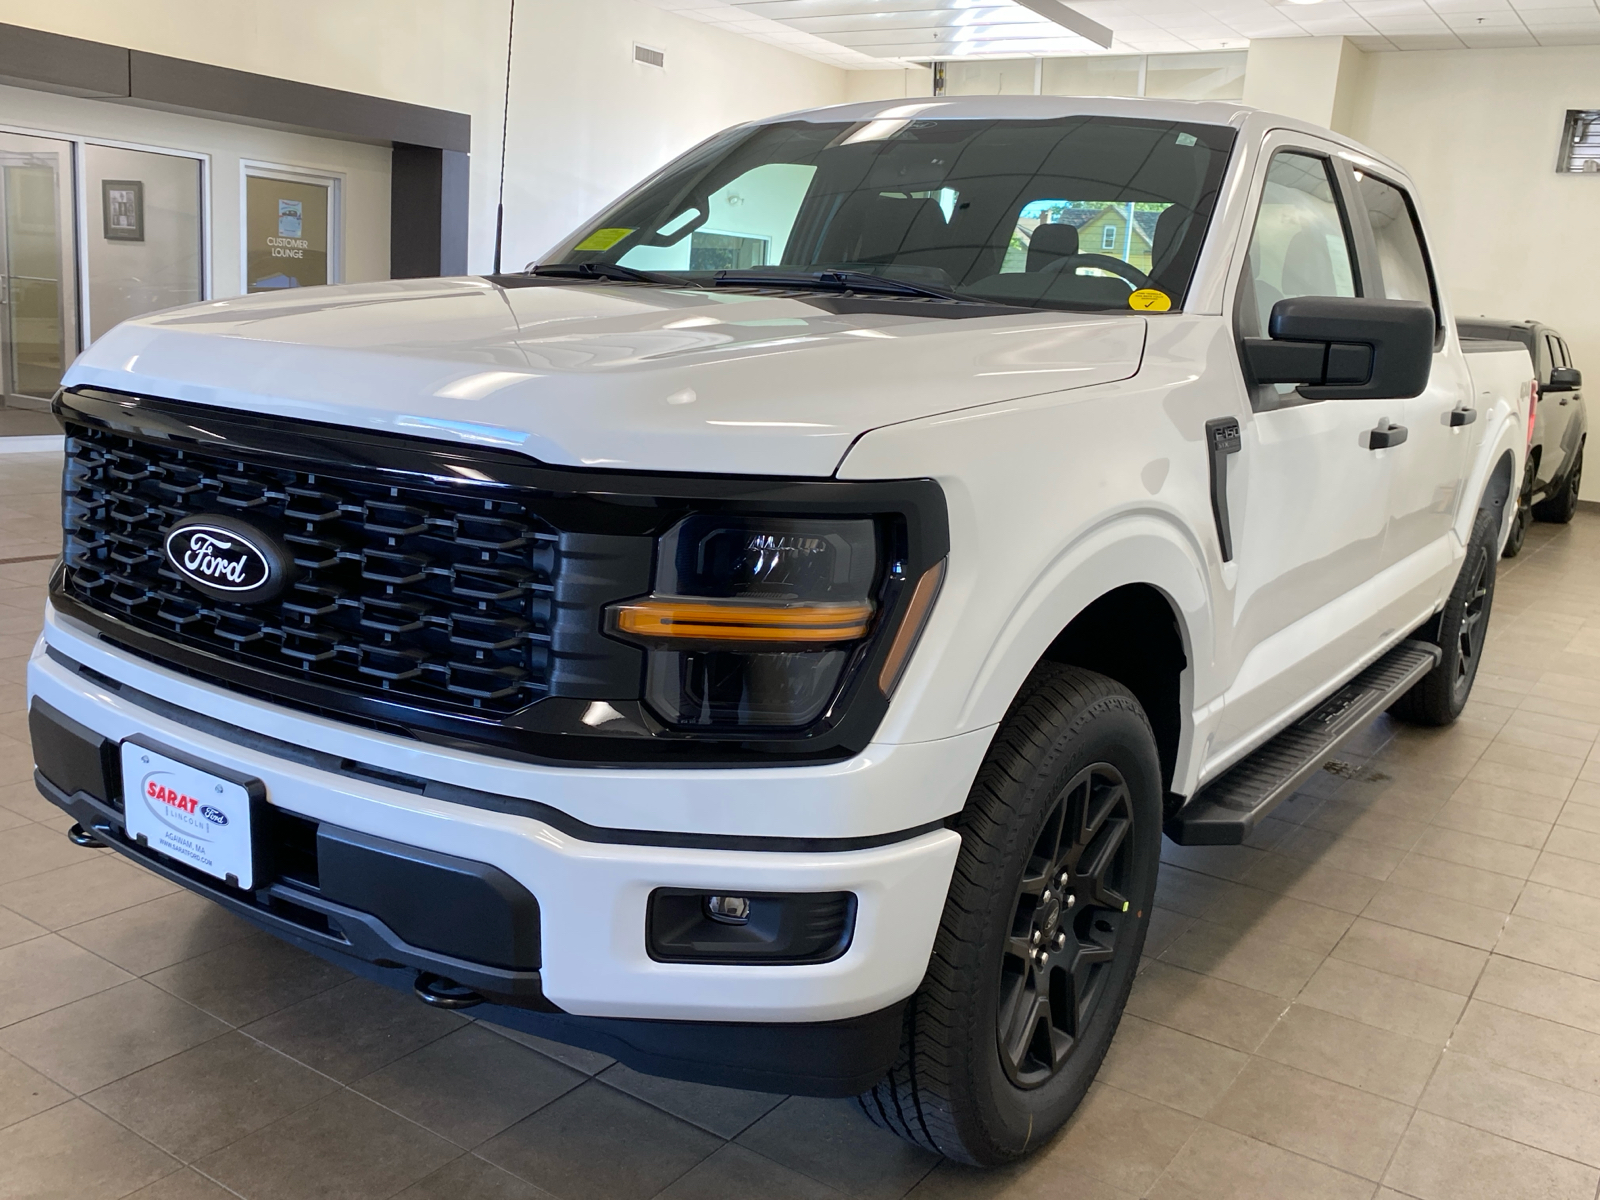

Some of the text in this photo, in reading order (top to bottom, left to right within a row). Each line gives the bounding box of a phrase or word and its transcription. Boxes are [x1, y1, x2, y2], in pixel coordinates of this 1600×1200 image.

[266, 236, 308, 249] CUSTOMER
[271, 247, 304, 259] LOUNGE
[1214, 426, 1240, 441] F-150
[184, 533, 248, 583] Ford
[146, 780, 199, 815] SARAT
[170, 809, 204, 830] LINCOLN
[203, 806, 225, 825] Ford
[195, 844, 206, 855] MA
